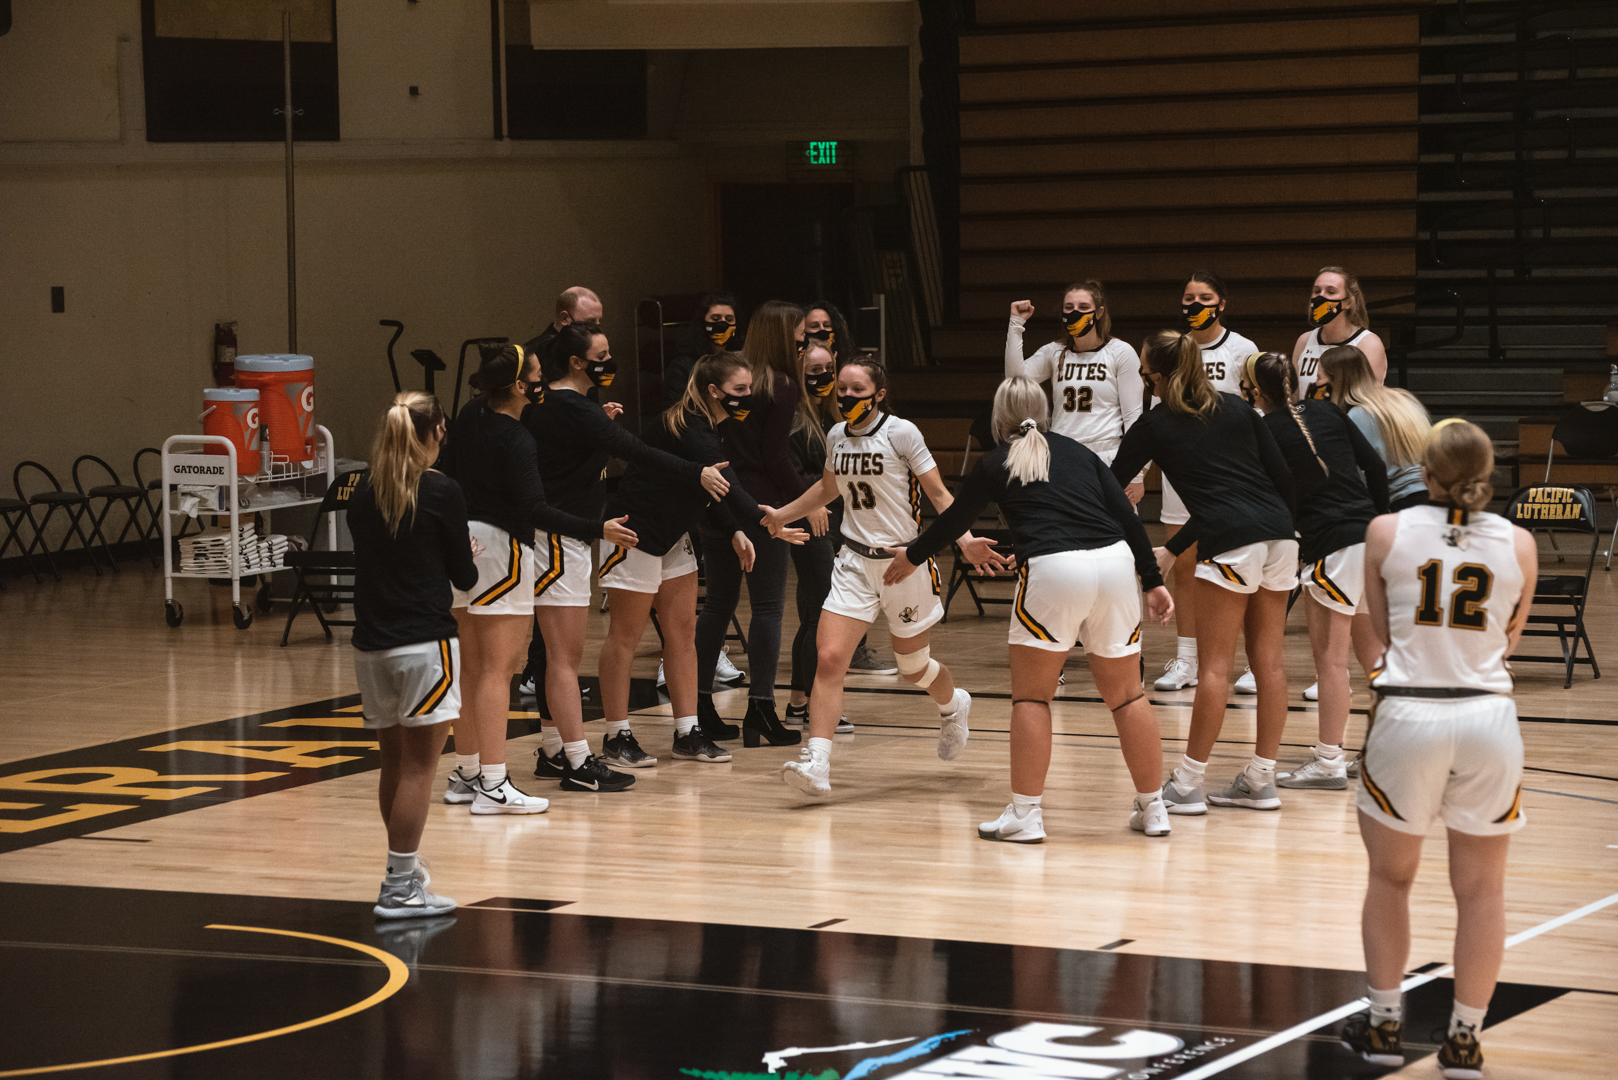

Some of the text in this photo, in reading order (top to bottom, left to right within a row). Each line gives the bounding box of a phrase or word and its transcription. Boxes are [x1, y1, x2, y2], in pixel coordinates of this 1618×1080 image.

[810, 141, 838, 164] EXIT
[301, 384, 314, 412] G
[1063, 386, 1093, 412] 32
[246, 407, 259, 429] G
[173, 465, 225, 475] GATORADE
[834, 452, 884, 475] LUTES
[847, 481, 876, 510] 13
[1528, 487, 1575, 503] PACIFIC
[1516, 503, 1582, 520] LUTHERAN
[1415, 558, 1494, 631] 12
[1116, 1037, 1236, 1080] ONFERENCE
